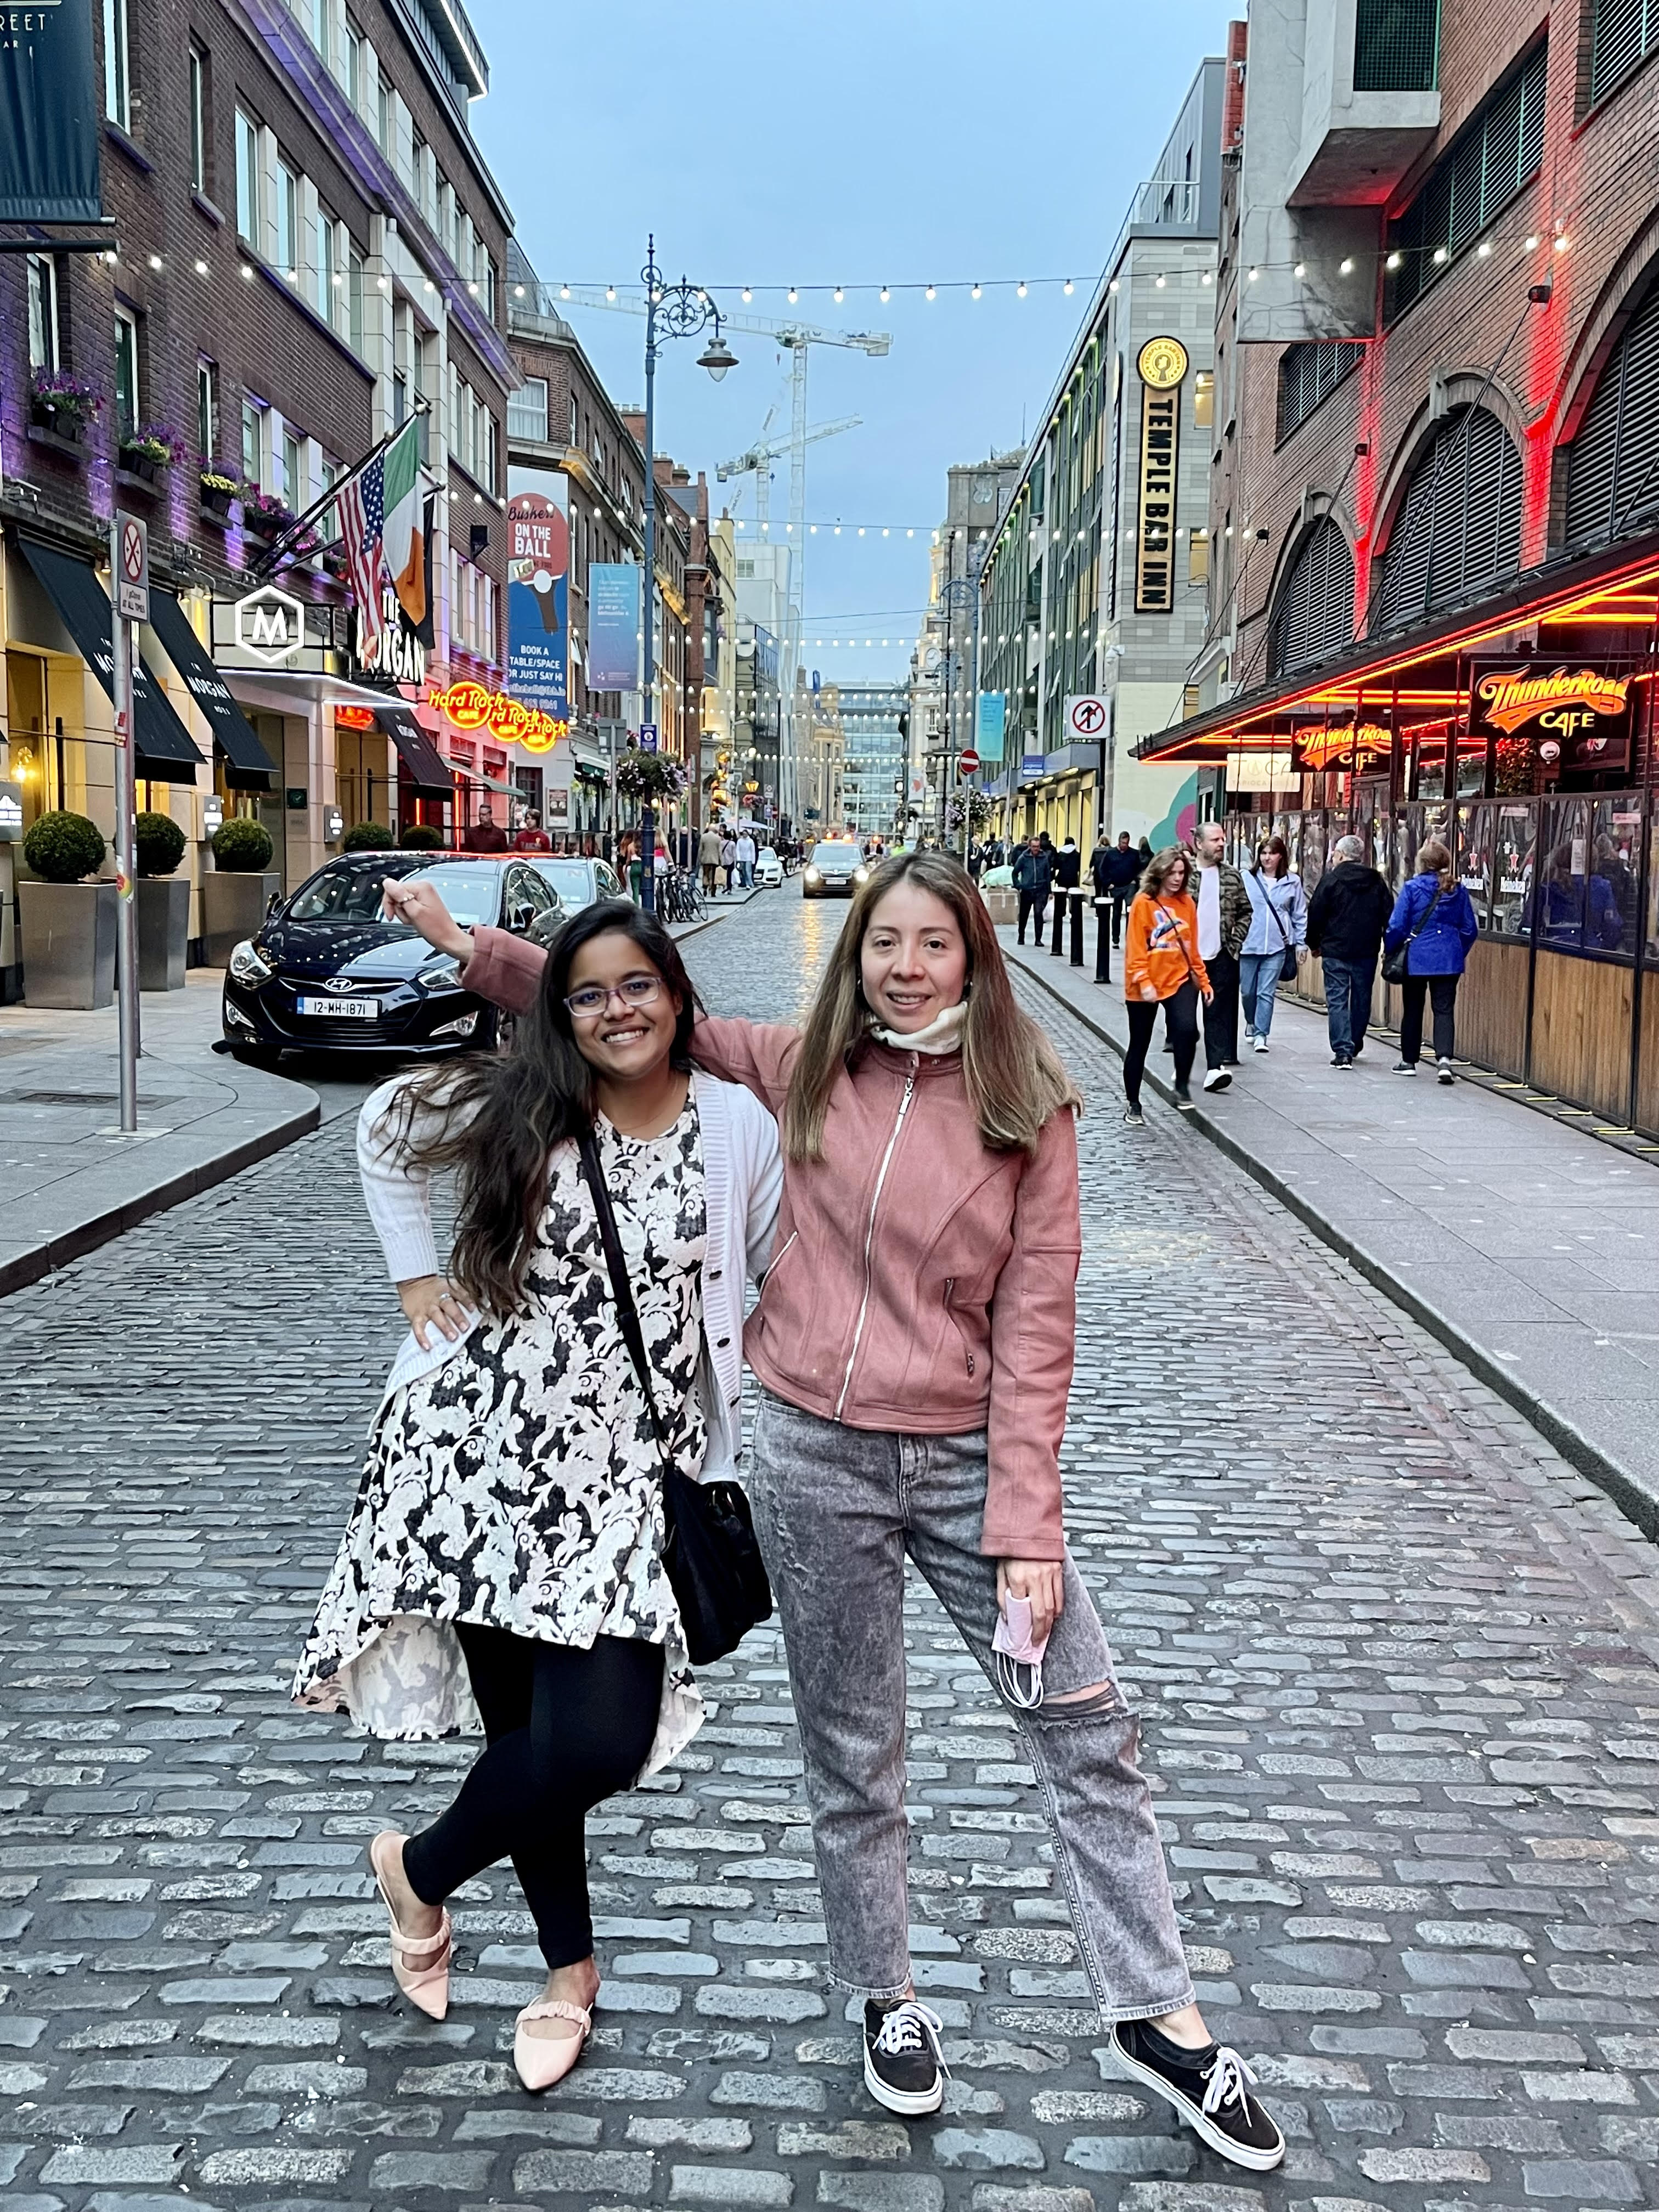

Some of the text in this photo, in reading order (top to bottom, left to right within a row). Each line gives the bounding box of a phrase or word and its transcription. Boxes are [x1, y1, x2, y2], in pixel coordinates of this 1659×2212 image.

[1142, 399, 1173, 605] TEMPLE BAR INN
[515, 523, 551, 540] ON THE
[515, 537, 551, 558] BALL
[252, 606, 288, 646] M
[521, 645, 549, 656] BOOK A
[509, 656, 560, 669] TABLE/SPACE
[520, 670, 538, 679] JUST
[539, 671, 554, 681] SAY
[555, 673, 563, 681] HI
[187, 675, 231, 699] MORGAN
[428, 690, 504, 710] Hard Rock
[457, 710, 480, 720] CAFE
[509, 707, 540, 725] Rock
[1539, 711, 1595, 739] CAFE
[314, 1002, 365, 1015] 12-MH-1871
